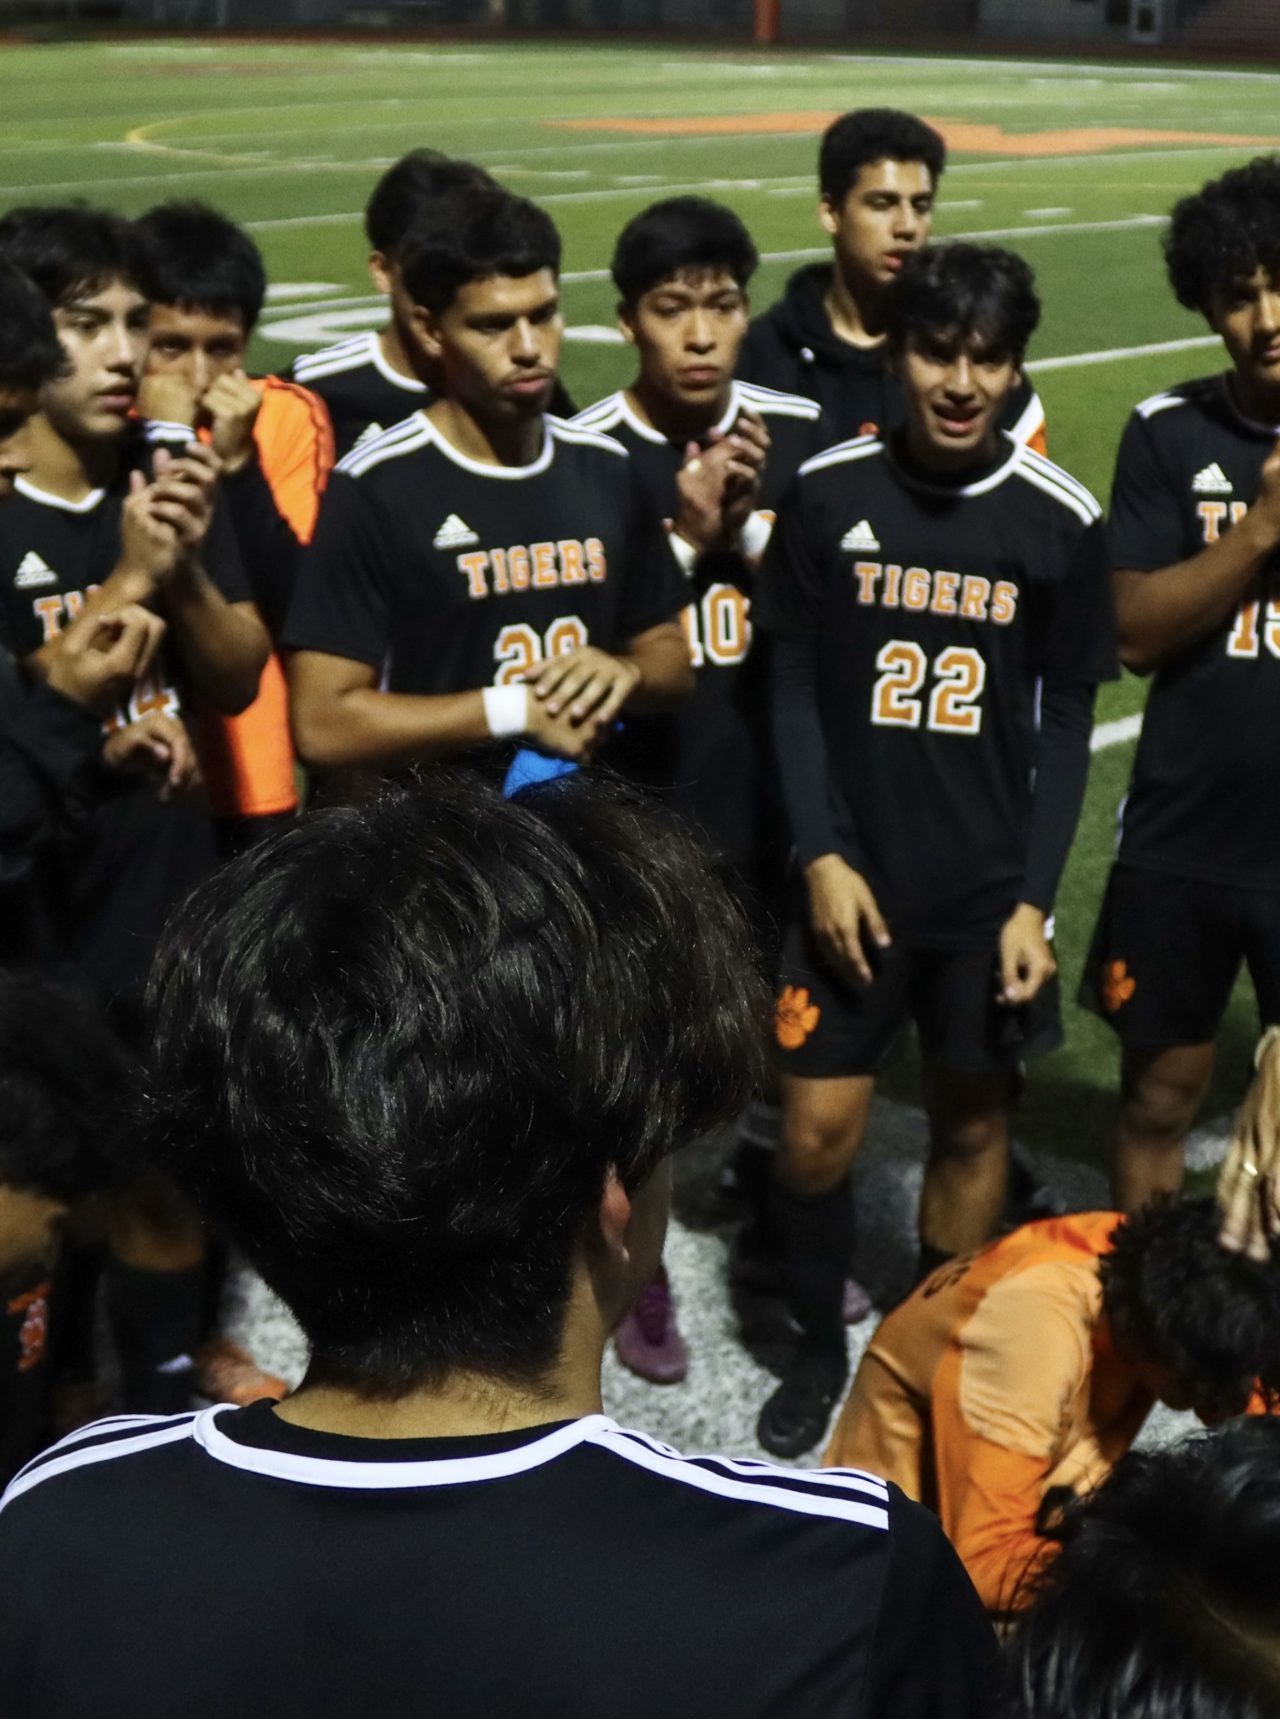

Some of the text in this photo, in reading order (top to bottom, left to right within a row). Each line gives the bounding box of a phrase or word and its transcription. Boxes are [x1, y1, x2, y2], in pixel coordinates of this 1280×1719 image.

[457, 538, 606, 599] TIGERS
[854, 561, 1018, 626] TIGERS
[870, 639, 986, 735] 22
